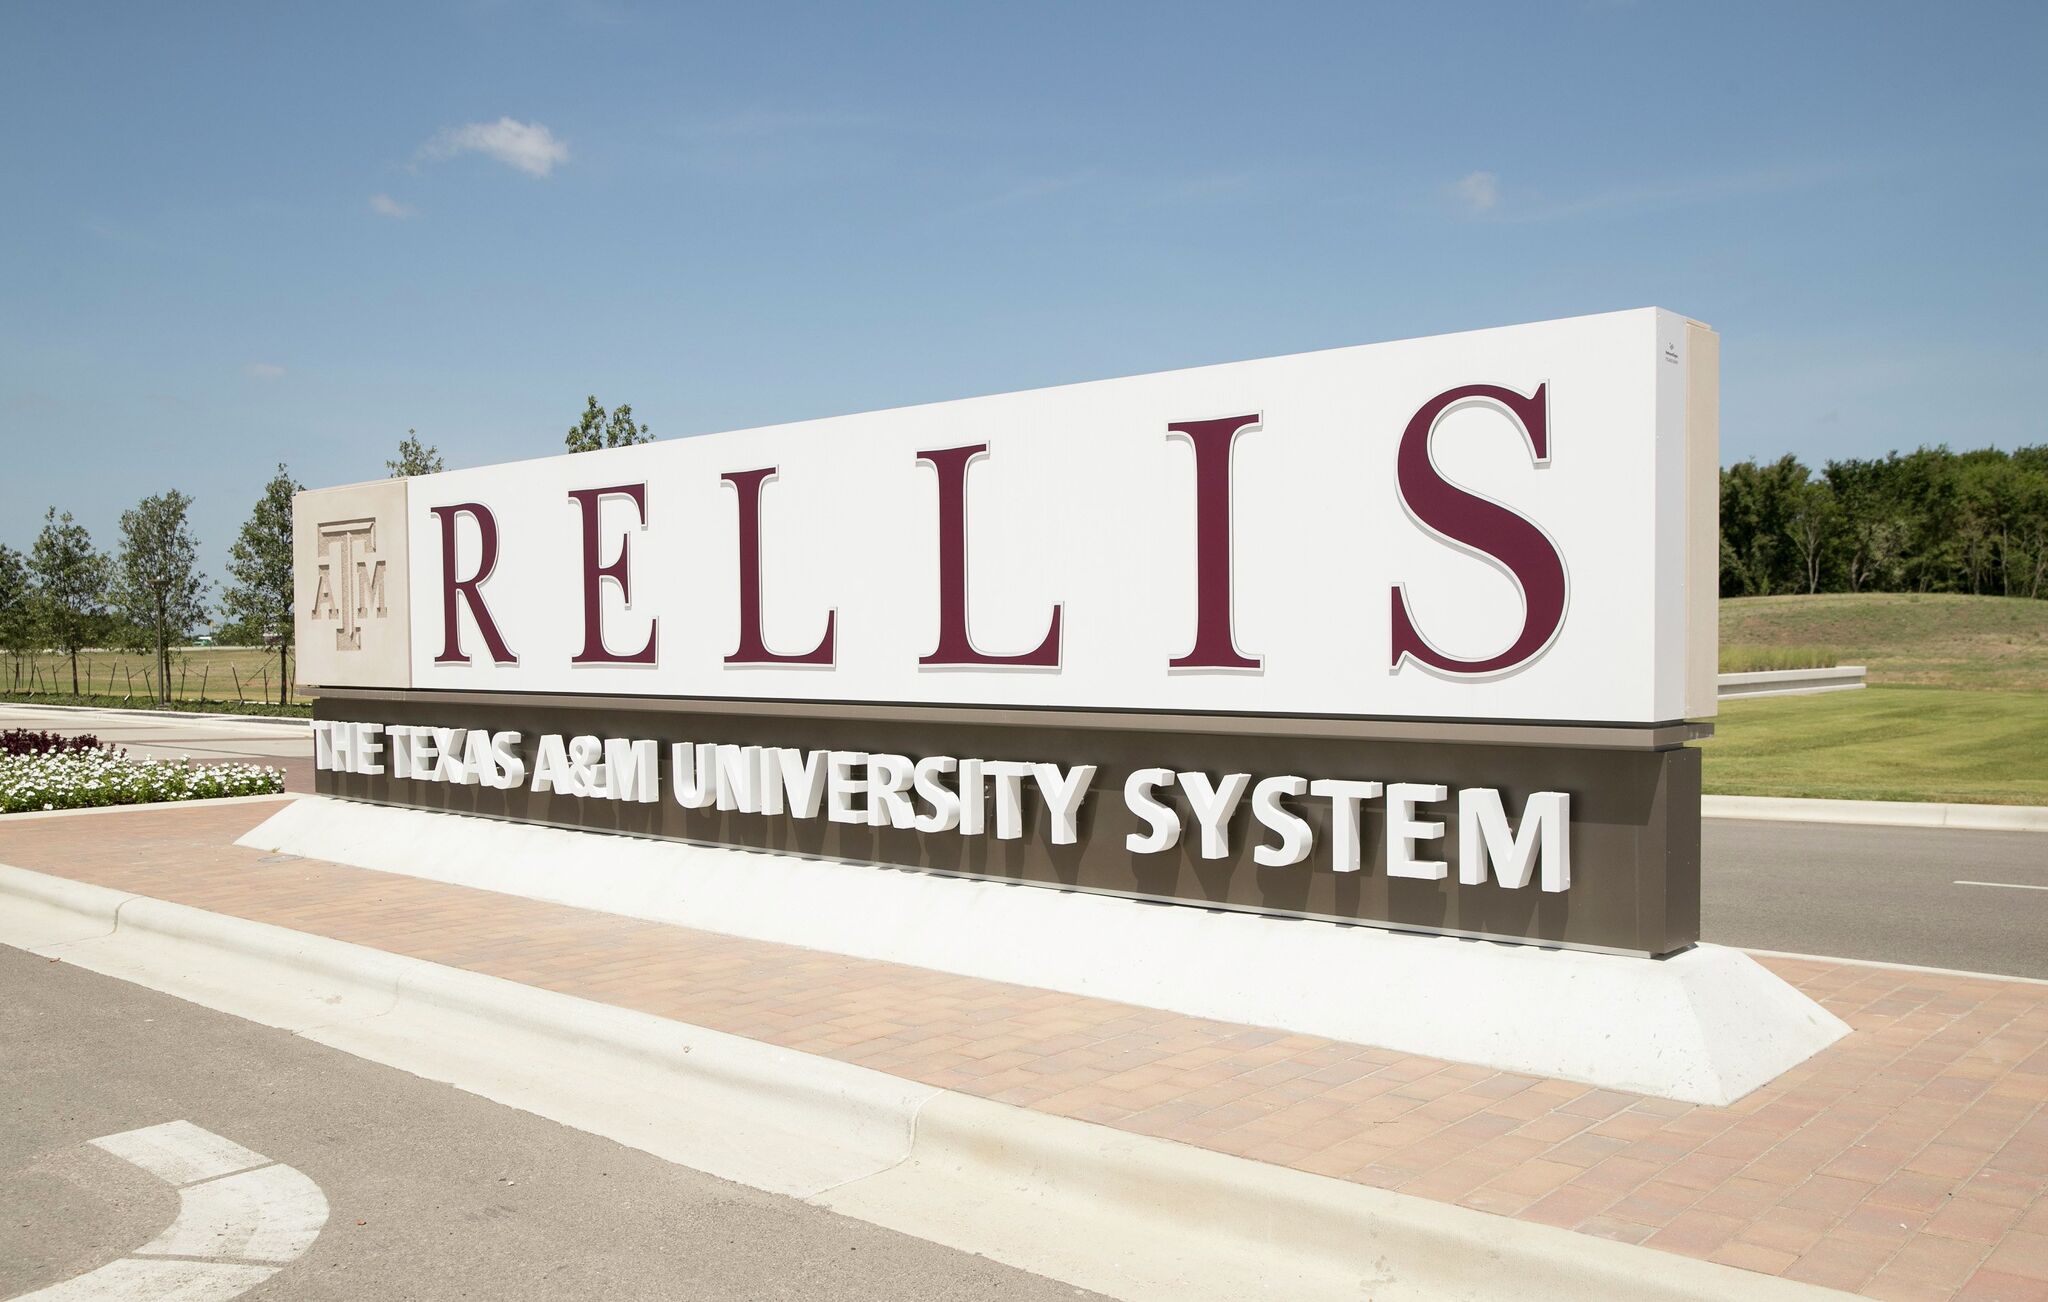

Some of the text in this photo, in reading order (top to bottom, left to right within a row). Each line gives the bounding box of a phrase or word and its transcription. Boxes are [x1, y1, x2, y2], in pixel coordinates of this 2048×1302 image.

[430, 381, 1568, 680] RELLIS
[310, 720, 1571, 893] THE TEXAS A&M UNIVERSITY SYSTEM
